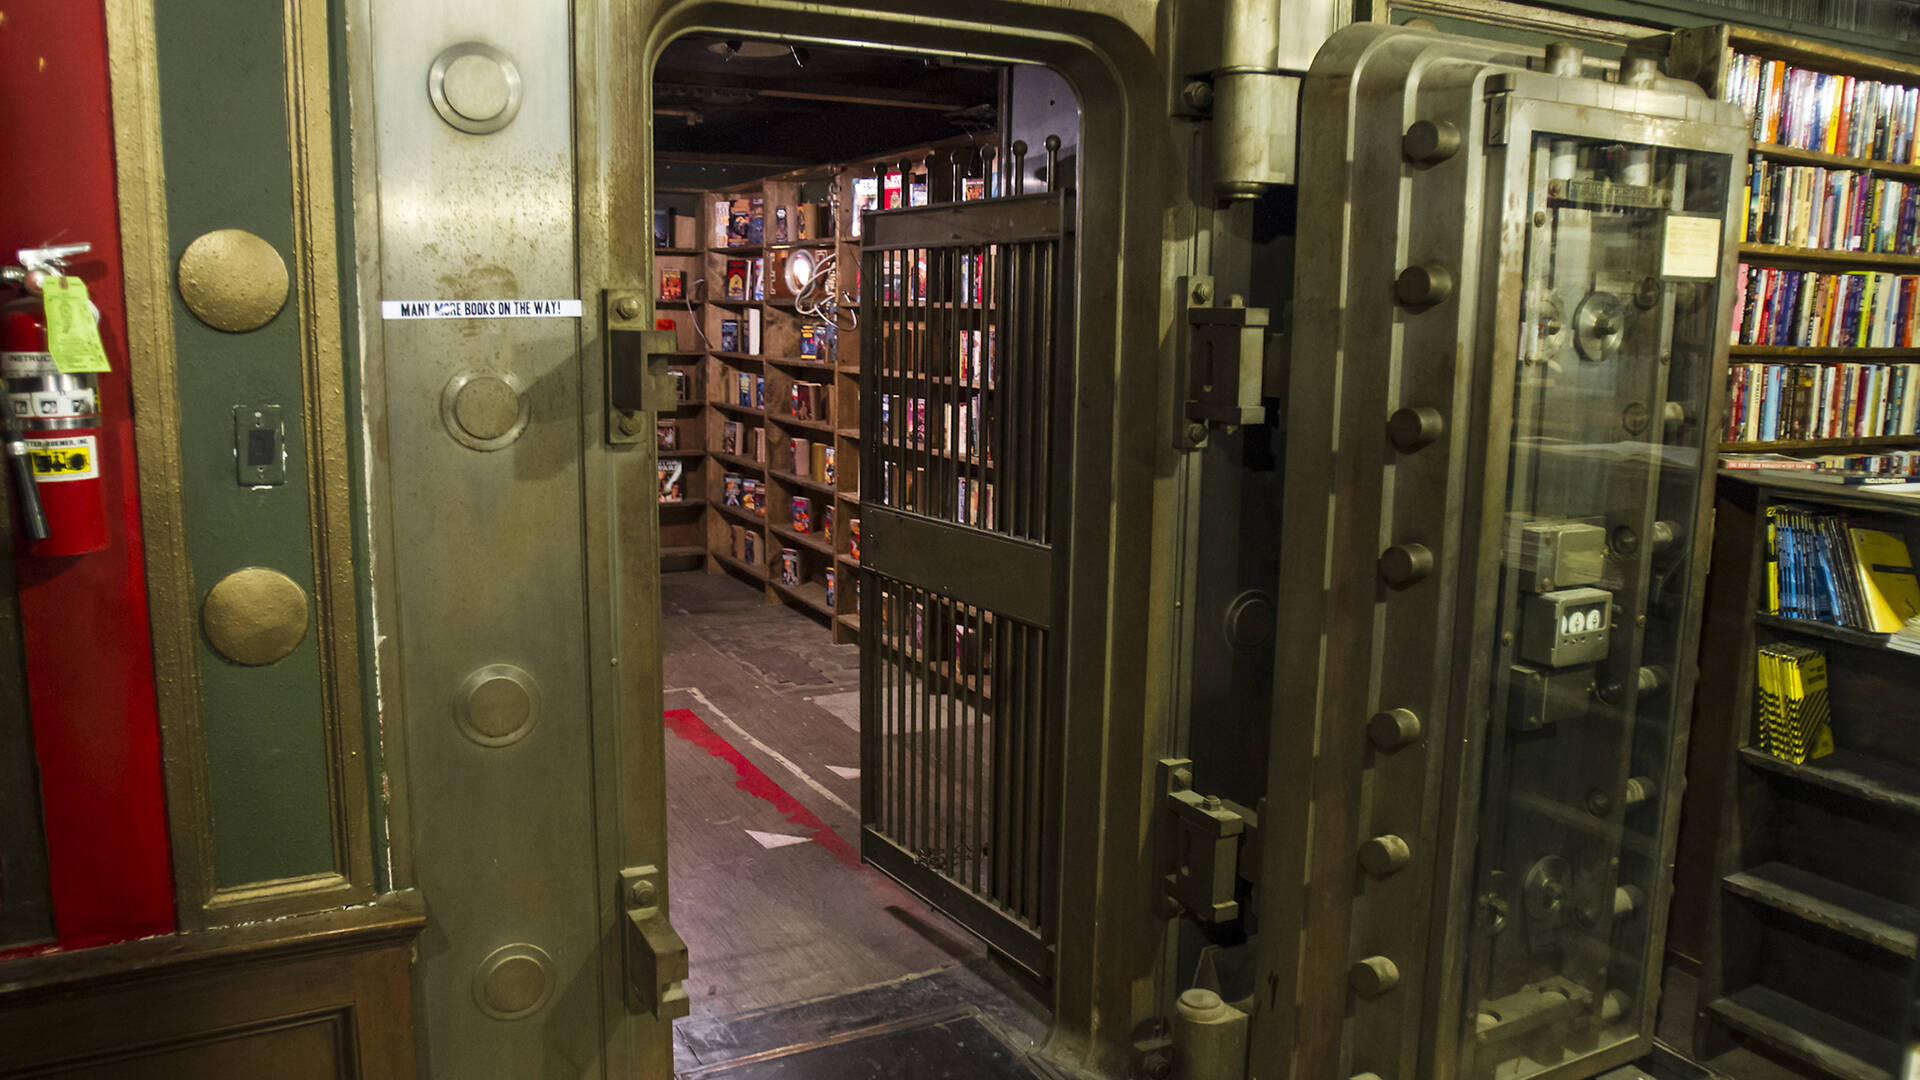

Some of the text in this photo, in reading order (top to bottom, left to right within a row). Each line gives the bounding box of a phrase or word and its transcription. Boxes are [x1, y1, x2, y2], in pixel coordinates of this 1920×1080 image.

[401, 303, 429, 316] MANY
[464, 302, 495, 315] BOOKS
[498, 302, 511, 315] ON
[514, 301, 531, 315] THE
[533, 301, 561, 315] WAY!
